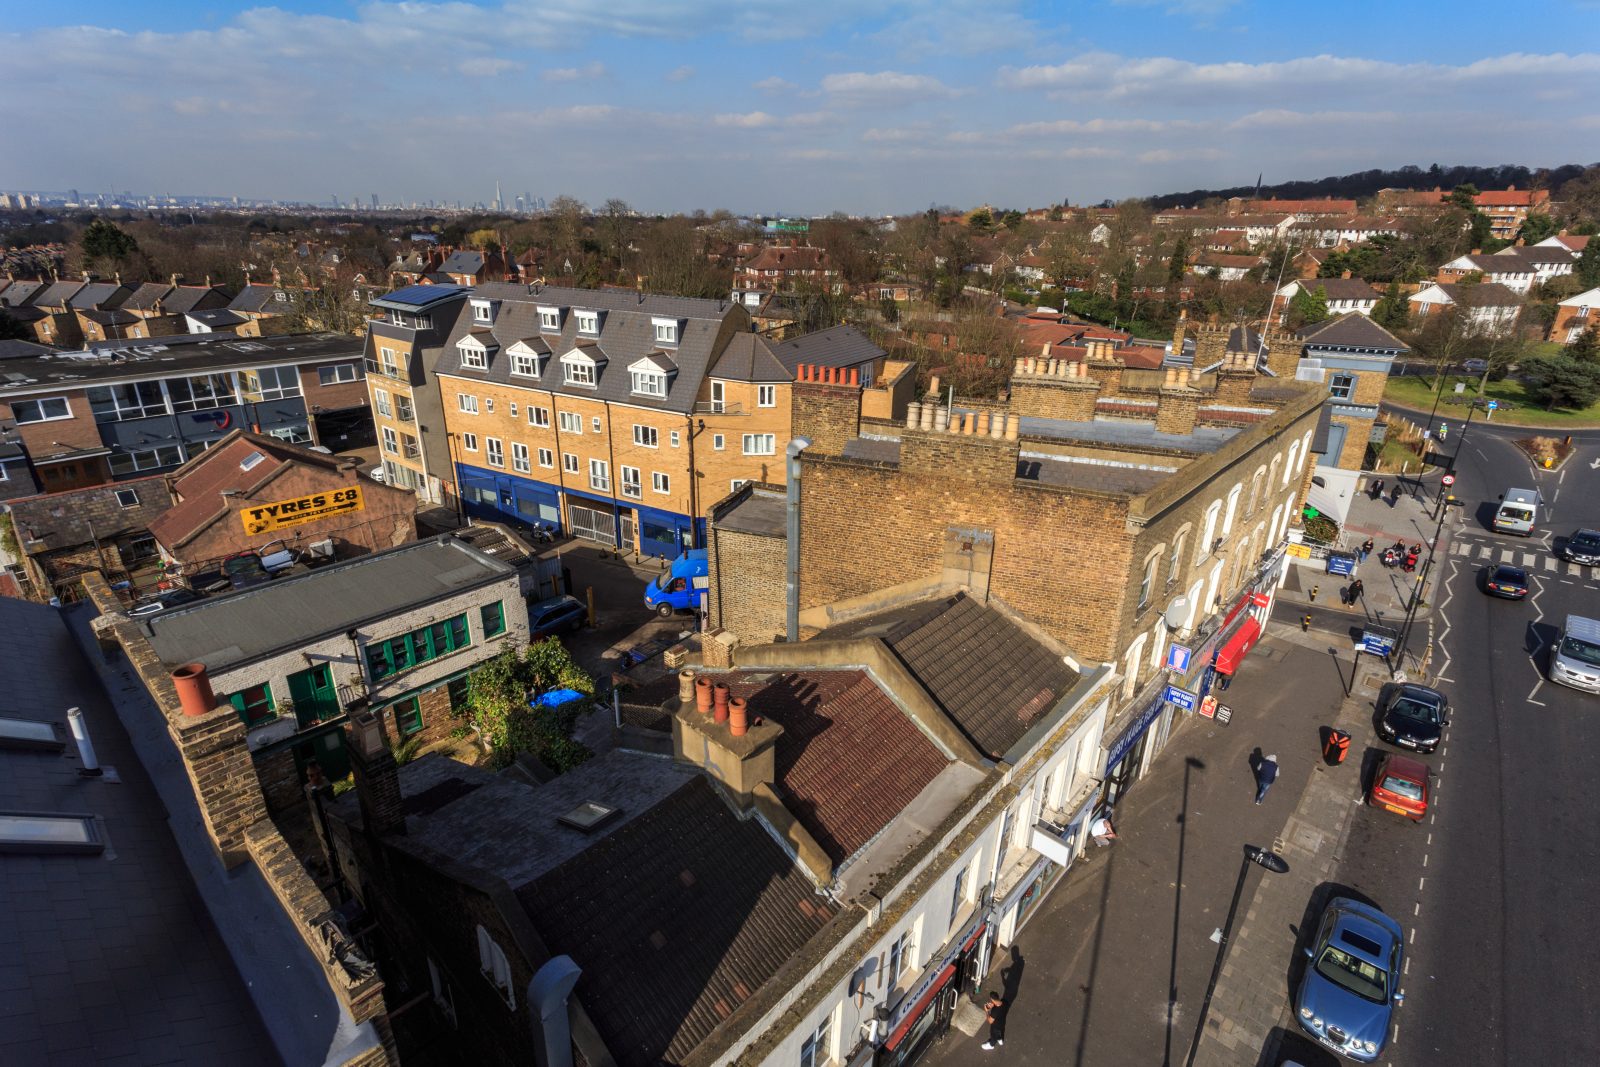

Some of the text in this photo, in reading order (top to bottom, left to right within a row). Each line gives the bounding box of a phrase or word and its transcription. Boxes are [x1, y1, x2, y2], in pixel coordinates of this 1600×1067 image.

[249, 496, 326, 520] TYRES
[333, 489, 358, 503] £8
[902, 979, 930, 1014] Ocean
